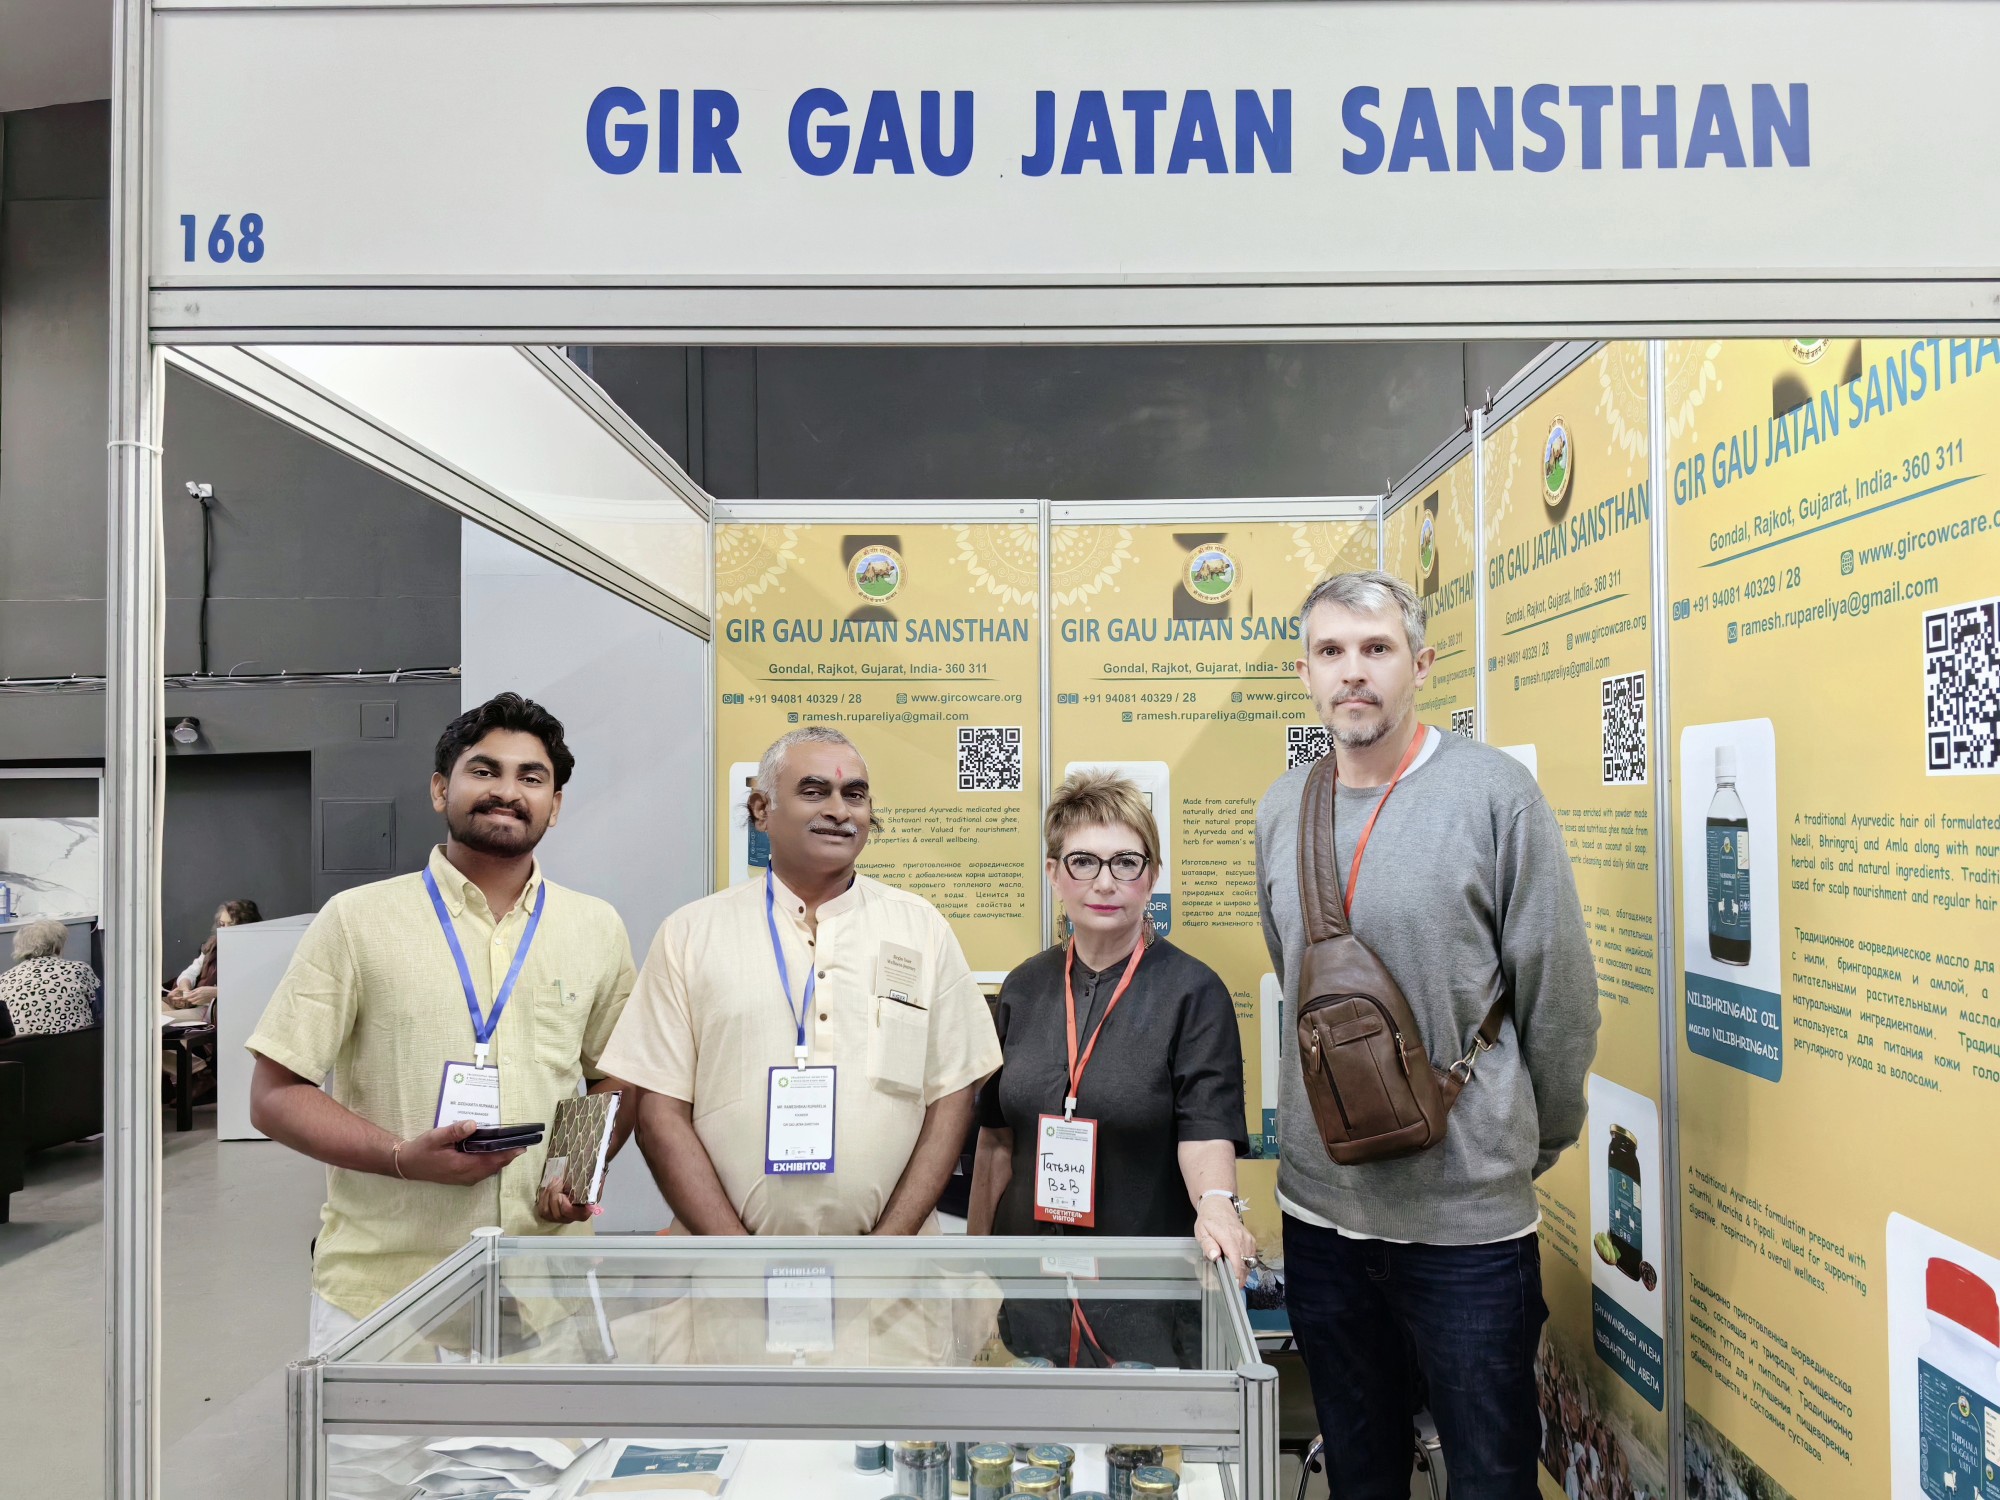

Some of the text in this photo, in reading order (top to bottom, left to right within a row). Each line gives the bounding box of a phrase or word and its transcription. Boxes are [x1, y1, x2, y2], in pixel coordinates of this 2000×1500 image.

[586, 83, 1810, 176] GIR GAU JATAN SANSTHAN
[180, 213, 265, 263] 168
[1673, 339, 2000, 505] GIR GAU JATAN SANSTHA
[1710, 438, 1963, 551] Gondal, Rajkot, Gujarat, India- 360 311
[1488, 480, 1650, 589] GIR GAU JATAN SANSTHAN
[1505, 569, 1621, 625] Gondal, Rajkot, Gujarat, India- 360 311
[1693, 592, 1709, 612] +91
[1712, 585, 1740, 609] 94081
[1744, 577, 1775, 603] 40329
[1786, 567, 1801, 589] 28
[1741, 576, 1938, 636] ramesh.rupareliya@gmail.com
[726, 619, 1028, 643] GIR GAU JATAN SANSTHAN
[1061, 616, 1300, 643] GIR GAU JATAN SANS
[1574, 616, 1646, 645] www.gircowcare.org
[769, 663, 987, 675] Gondal, Rajkot, Gujarat, India- 360 311
[1103, 663, 1278, 674] Gondal, Rajkot, Gujarat, India-
[1520, 656, 1610, 688] ramesh.rupareliya@gmail.com
[748, 694, 767, 704] +91
[771, 694, 802, 704] 94081
[807, 694, 838, 704] 40329
[848, 694, 862, 703] 28
[911, 693, 1021, 704] www.gircowcare.org
[1082, 694, 1102, 703] +91
[1105, 693, 1137, 703] 94081
[1141, 693, 1172, 703] 40329
[1183, 693, 1196, 702] 28
[802, 711, 969, 723] ramesh.rupareliya@gmail.com
[1136, 710, 1305, 722] ramesh.rupareliya@gmail.com
[1794, 813, 2000, 830] A traditional Ayurvedic hair oil formulated
[1791, 834, 1968, 858] Neeli, Bhringraj and Amla along with
[1791, 855, 1954, 881] herbal oils and natural ingredients.
[1792, 879, 1997, 911] used for scalp nourishment and regular hair
[1795, 927, 1994, 973] Традиционное аюрведическое масло для
[1804, 953, 1828, 969] нили,
[1837, 956, 1902, 982] брингараджем
[1912, 975, 1919, 984] и
[1930, 978, 1968, 997] амлой,
[1687, 991, 1779, 1030] NILIBHRINGADI OIL
[1688, 1023, 1779, 1061] масло NILIBHRINGADI
[1794, 1037, 1942, 1092] регулярного ухода за волосами.
[773, 1162, 826, 1172] EXHIBITOR
[1041, 1153, 1085, 1174] Татьяна
[1045, 1208, 1082, 1218] ПОСЕТИТЕЛЬ
[1688, 1166, 1866, 1269] A traditional Ayurvedic formulation prepared with
[1717, 1200, 1743, 1222] Maricha
[1781, 1237, 1804, 1257] valued
[1808, 1249, 1820, 1265] for
[1824, 1261, 1866, 1297] supporting
[1767, 1250, 1827, 1293] overall wellness.
[1639, 1340, 1660, 1365] AVLEHA
